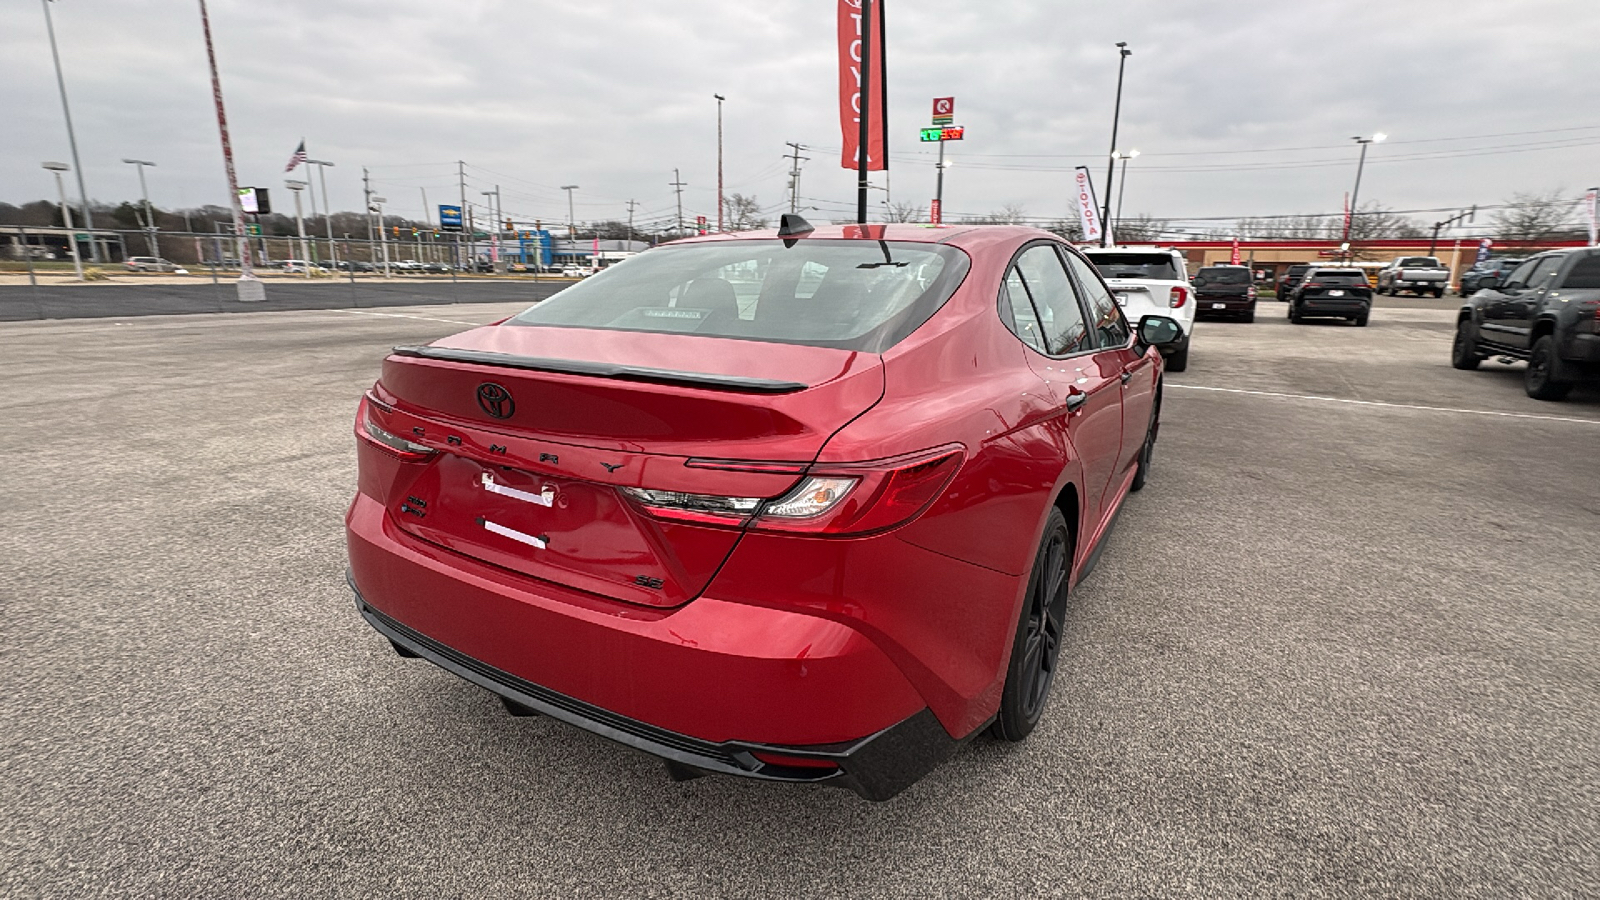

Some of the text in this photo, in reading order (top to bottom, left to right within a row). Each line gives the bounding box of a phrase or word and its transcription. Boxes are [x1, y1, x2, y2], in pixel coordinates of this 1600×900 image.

[1079, 185, 1098, 235] TOYOTA
[412, 426, 625, 472] CAMRY
[635, 574, 666, 590] SE
